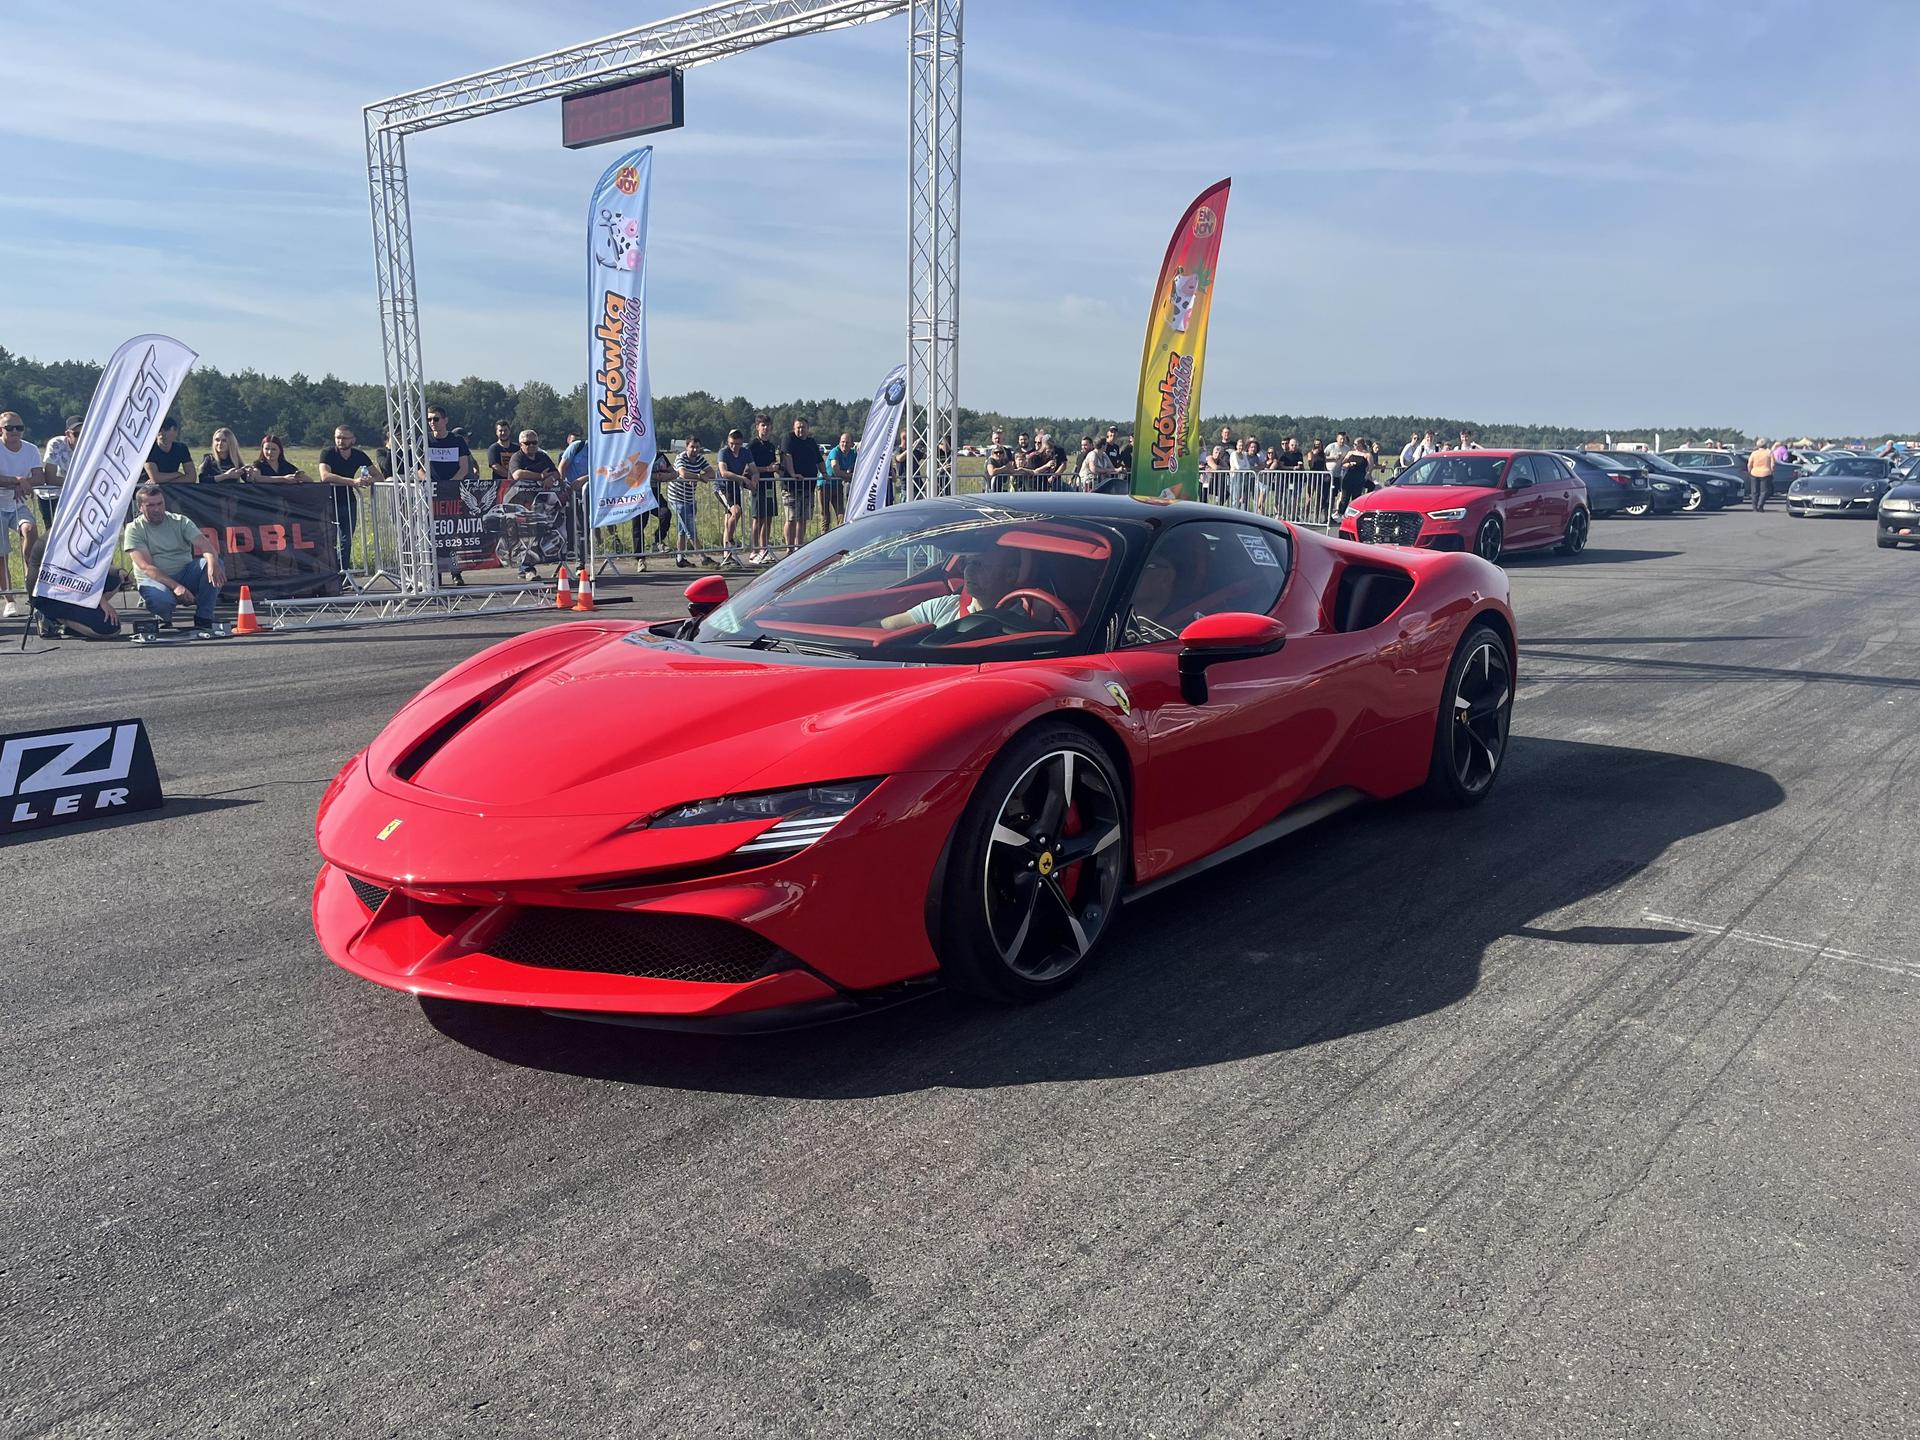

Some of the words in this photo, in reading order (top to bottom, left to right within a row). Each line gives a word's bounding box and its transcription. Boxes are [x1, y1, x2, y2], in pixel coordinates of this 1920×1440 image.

[616, 180, 638, 192] JOY
[595, 290, 628, 434] Krówka
[1151, 352, 1181, 471] Krówka
[866, 482, 878, 511] BMW
[434, 519, 454, 535] EGO
[456, 518, 483, 534] AUTA
[445, 539, 462, 547] 829
[464, 537, 480, 546] 356
[40, 569, 57, 583] RAG
